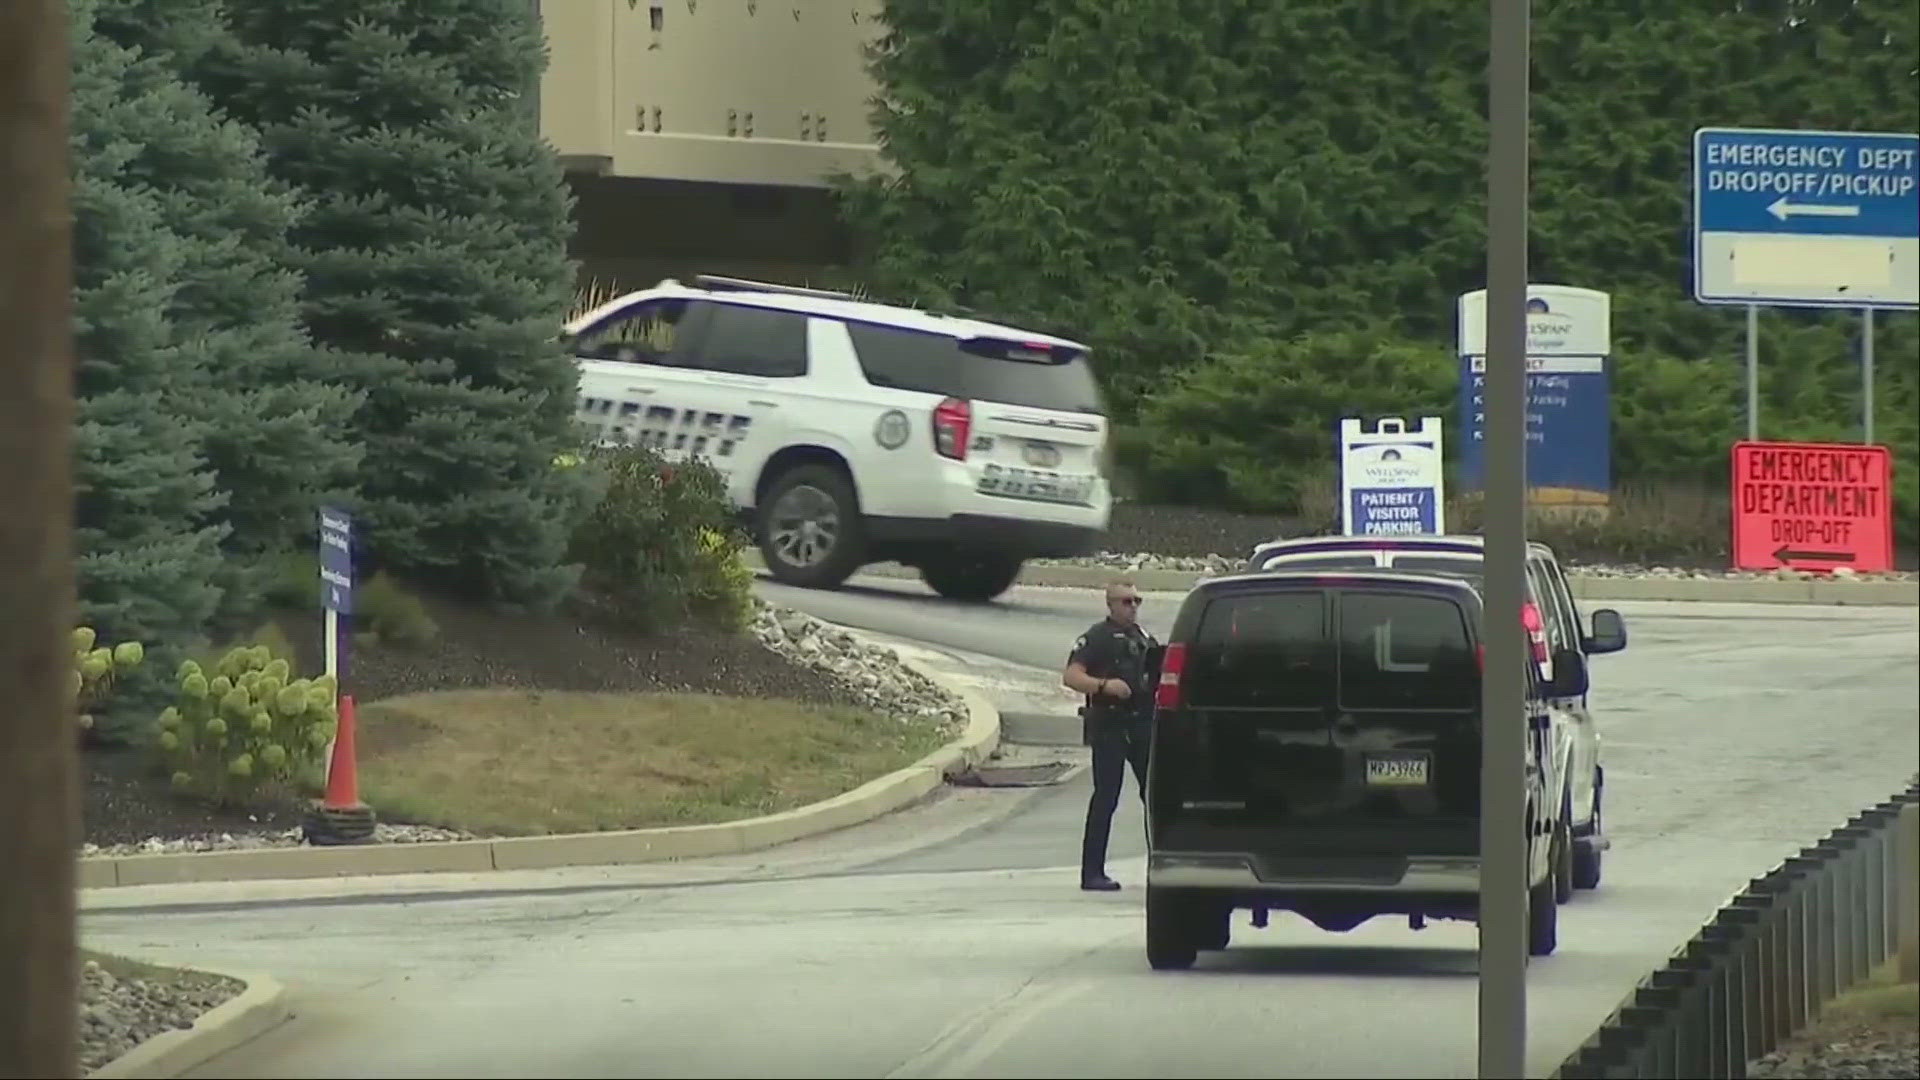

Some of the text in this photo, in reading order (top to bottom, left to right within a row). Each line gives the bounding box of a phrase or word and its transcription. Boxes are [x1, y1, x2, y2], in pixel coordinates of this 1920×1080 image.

[1707, 143, 1915, 170] EMERGENCY DEPT
[1708, 170, 1915, 197] DROPOFF/PICKUP
[1749, 450, 1871, 483] EMERGENCY
[1361, 492, 1415, 506] PATIENT
[1743, 483, 1879, 517] DEPARTMENT
[1367, 506, 1419, 520] VISITOR
[1364, 520, 1423, 534] PARKING
[1771, 519, 1853, 545] DROP-OFF
